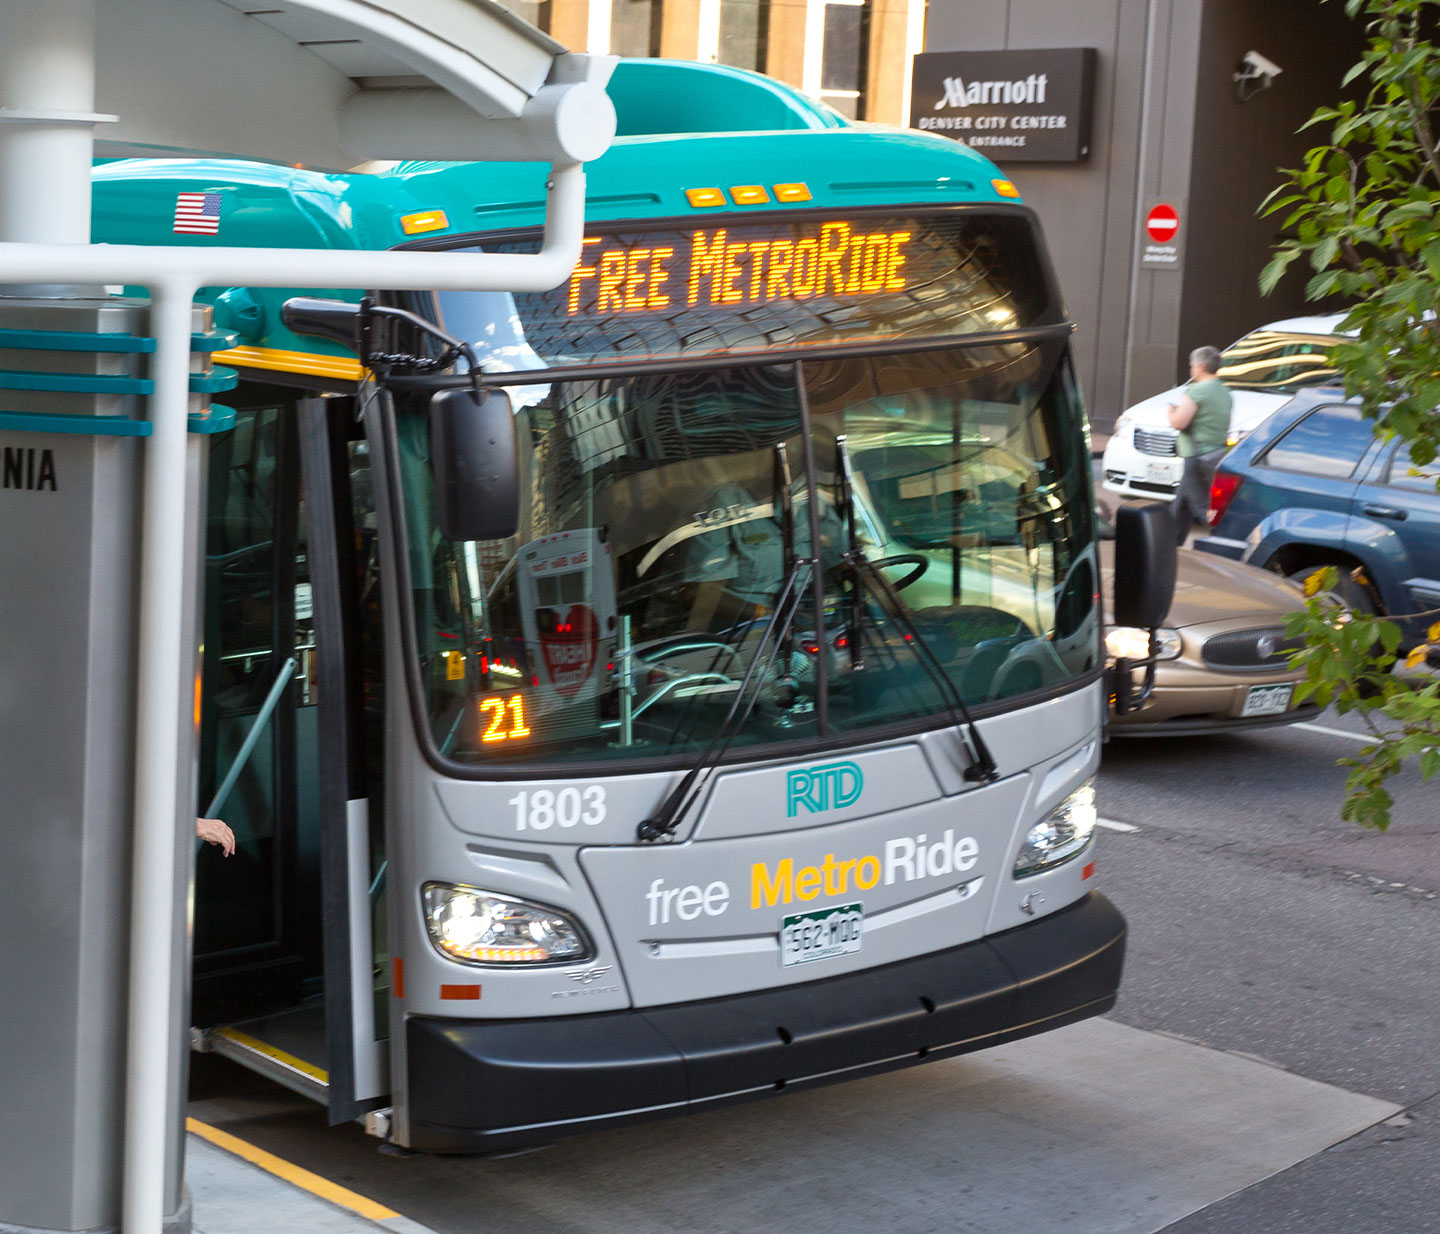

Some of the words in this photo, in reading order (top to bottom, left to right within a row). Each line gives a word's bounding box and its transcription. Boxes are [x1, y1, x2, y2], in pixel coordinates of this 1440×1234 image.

[934, 73, 1048, 111] Marriott
[918, 116, 972, 130] DENVER
[975, 115, 1008, 130] CITY
[1010, 115, 1067, 130] CENTER
[968, 135, 1027, 147] ENTRANCE
[480, 694, 530, 742] 21
[508, 785, 607, 832] 1803
[786, 760, 864, 818] RTD
[645, 878, 730, 926] free
